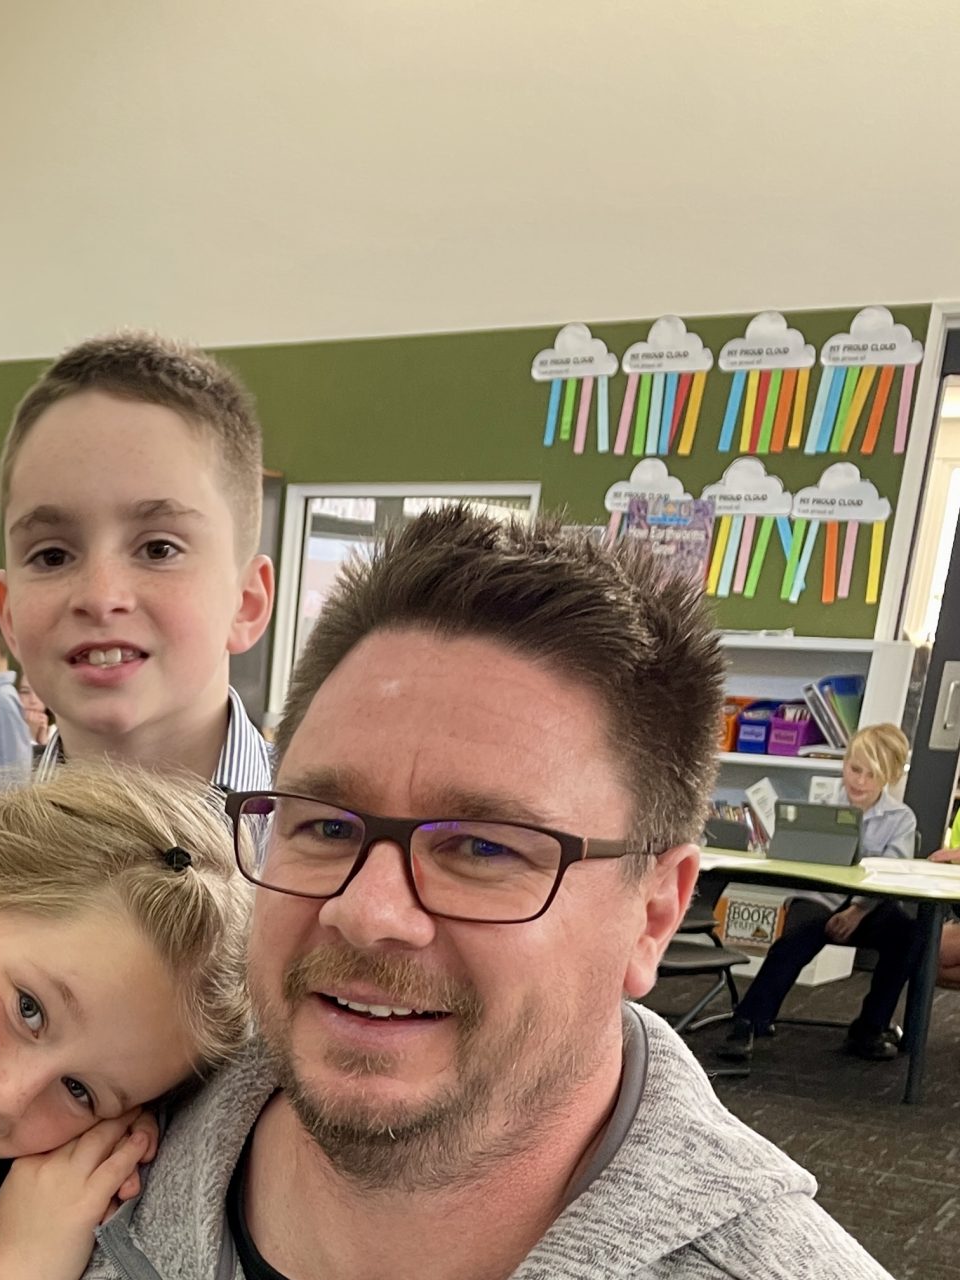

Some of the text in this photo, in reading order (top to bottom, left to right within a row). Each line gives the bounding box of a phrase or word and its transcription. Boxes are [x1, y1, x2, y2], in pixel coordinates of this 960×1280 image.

[766, 347, 789, 355] CLOUD
[870, 343, 896, 351] CLOUD
[732, 906, 773, 925] BOOK
